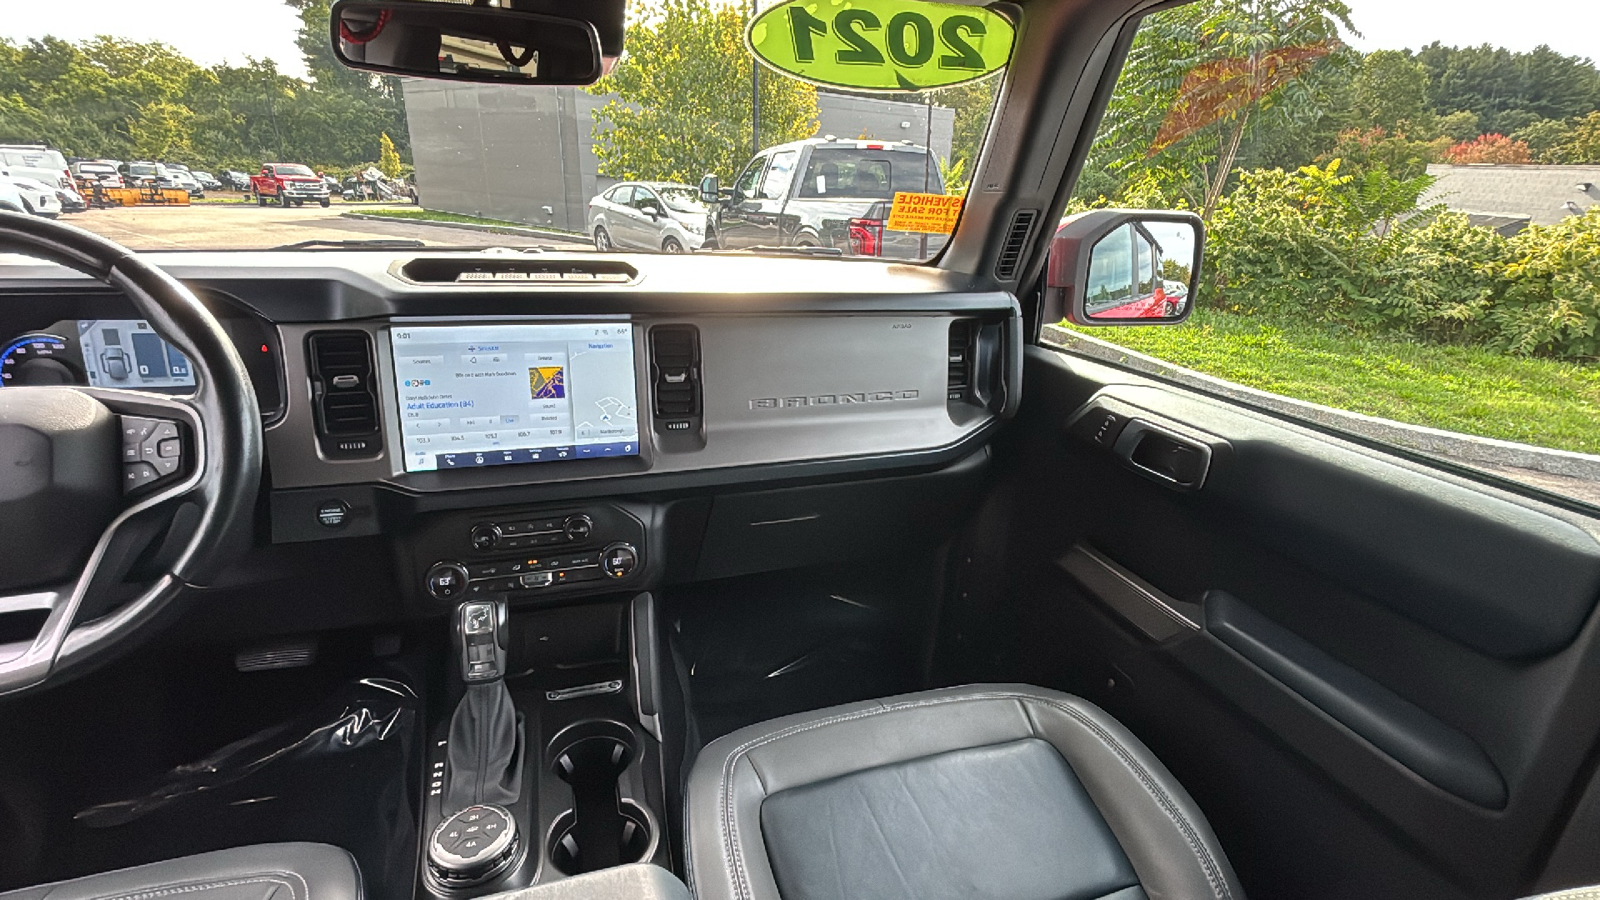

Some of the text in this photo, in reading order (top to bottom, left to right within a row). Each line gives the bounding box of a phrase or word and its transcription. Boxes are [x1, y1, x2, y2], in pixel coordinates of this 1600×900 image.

[406, 402, 425, 410] Adult
[426, 401, 459, 409] Education
[749, 389, 919, 410] BRONCO
